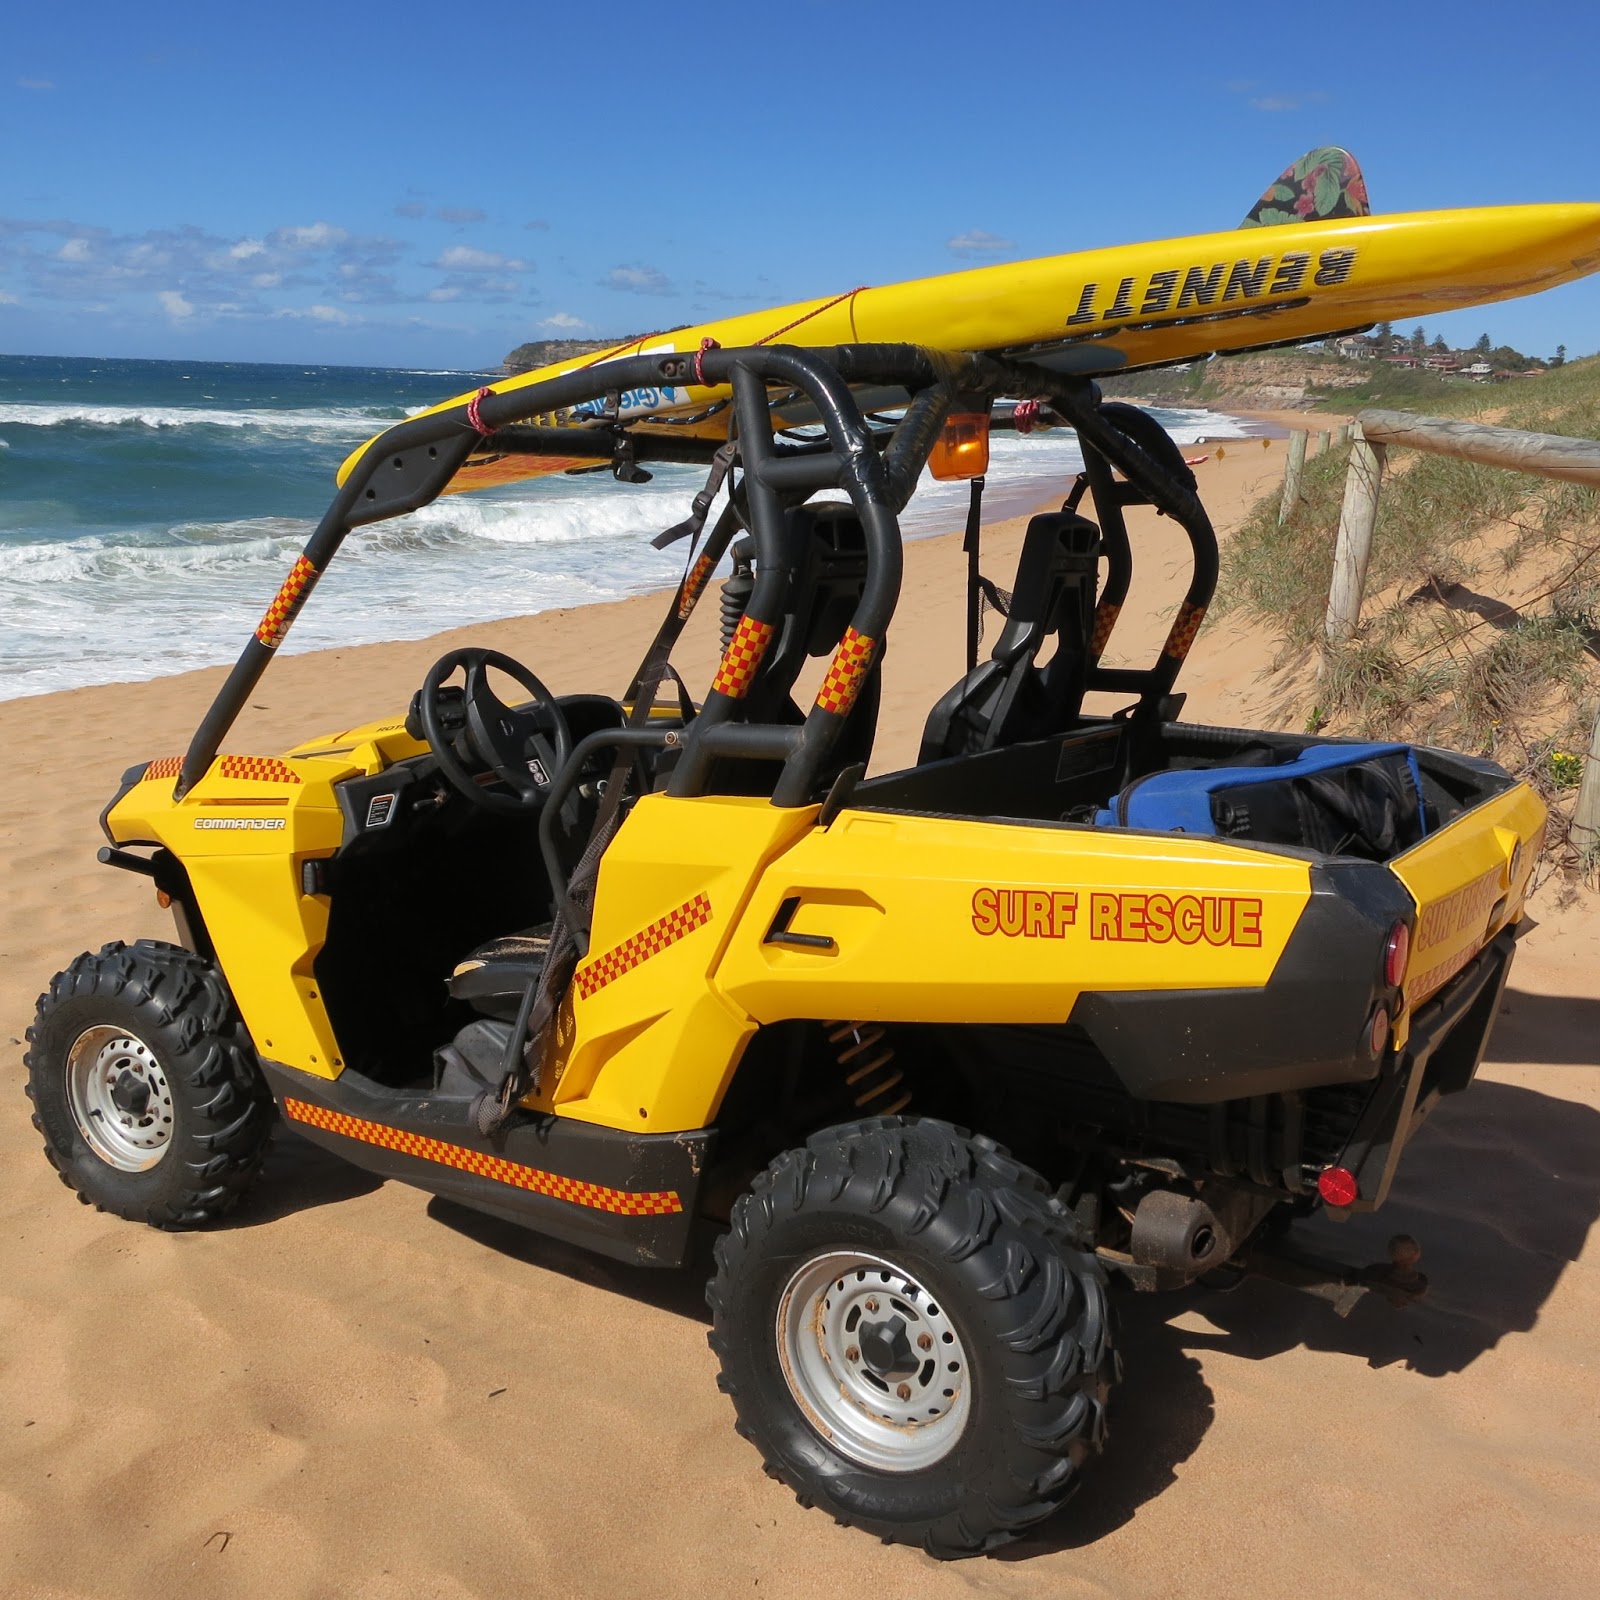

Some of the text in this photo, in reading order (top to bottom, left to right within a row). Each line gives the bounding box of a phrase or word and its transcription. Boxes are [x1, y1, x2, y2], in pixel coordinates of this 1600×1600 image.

[1066, 246, 1358, 326] BENNETT
[194, 817, 286, 831] COMMANDER
[971, 887, 1262, 948] SURF RESCUE
